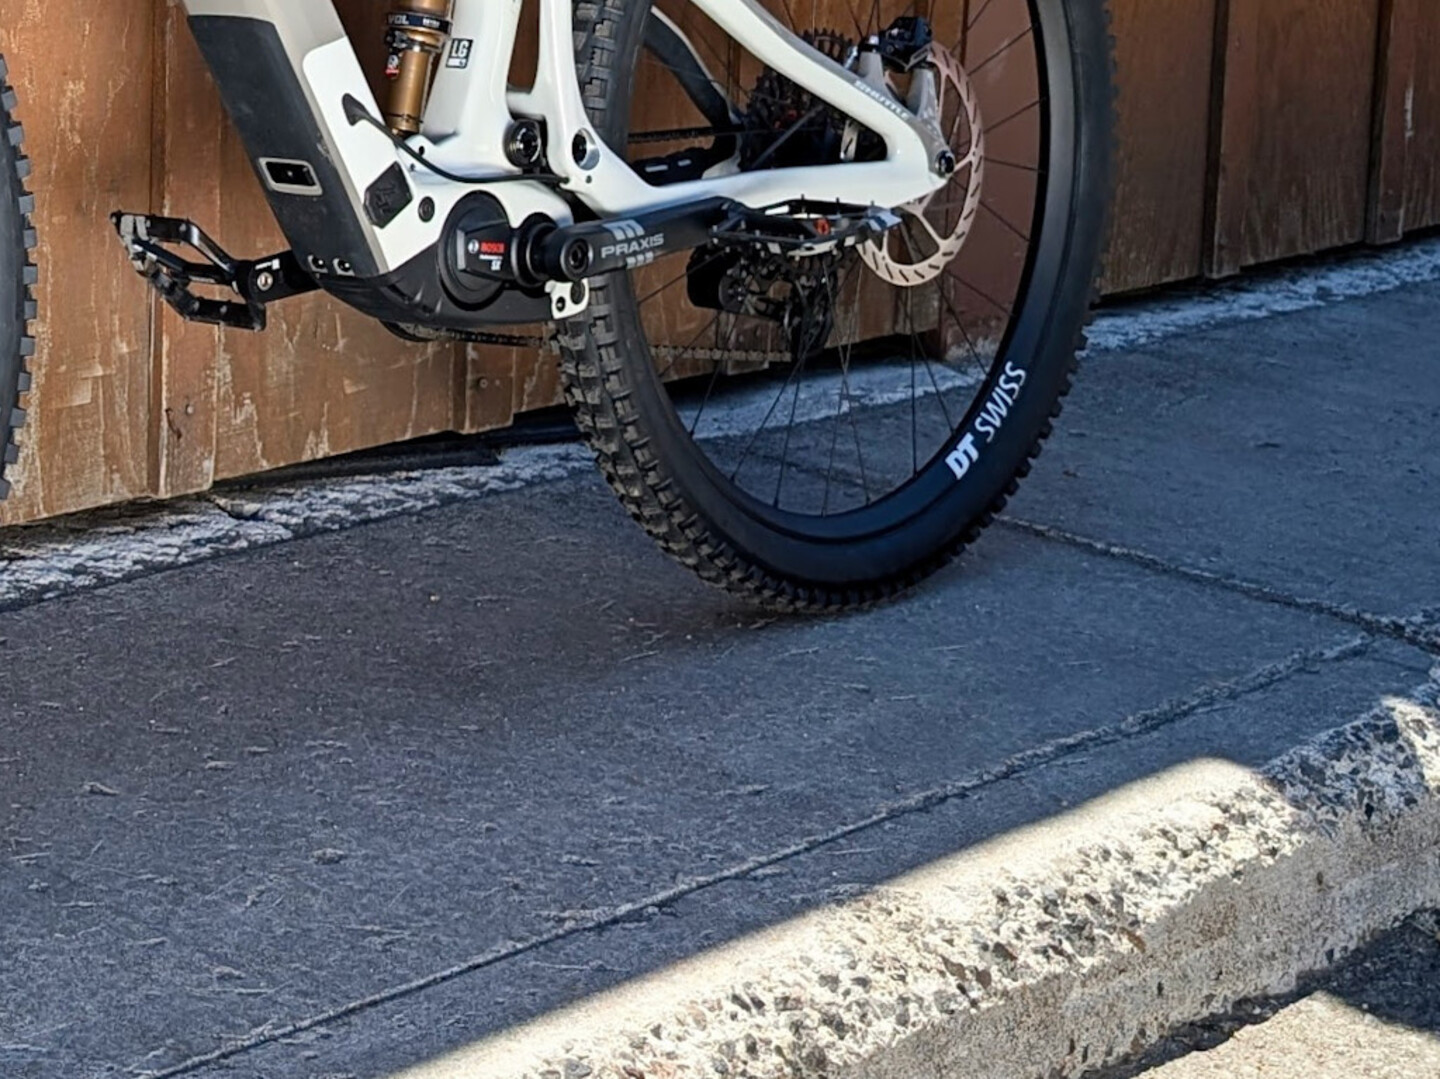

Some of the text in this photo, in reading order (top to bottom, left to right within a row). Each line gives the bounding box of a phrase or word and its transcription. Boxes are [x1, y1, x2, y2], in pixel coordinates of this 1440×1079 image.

[451, 41, 469, 57] LG
[600, 232, 665, 259] PRAXIS
[944, 361, 1027, 480] DT SWISS
